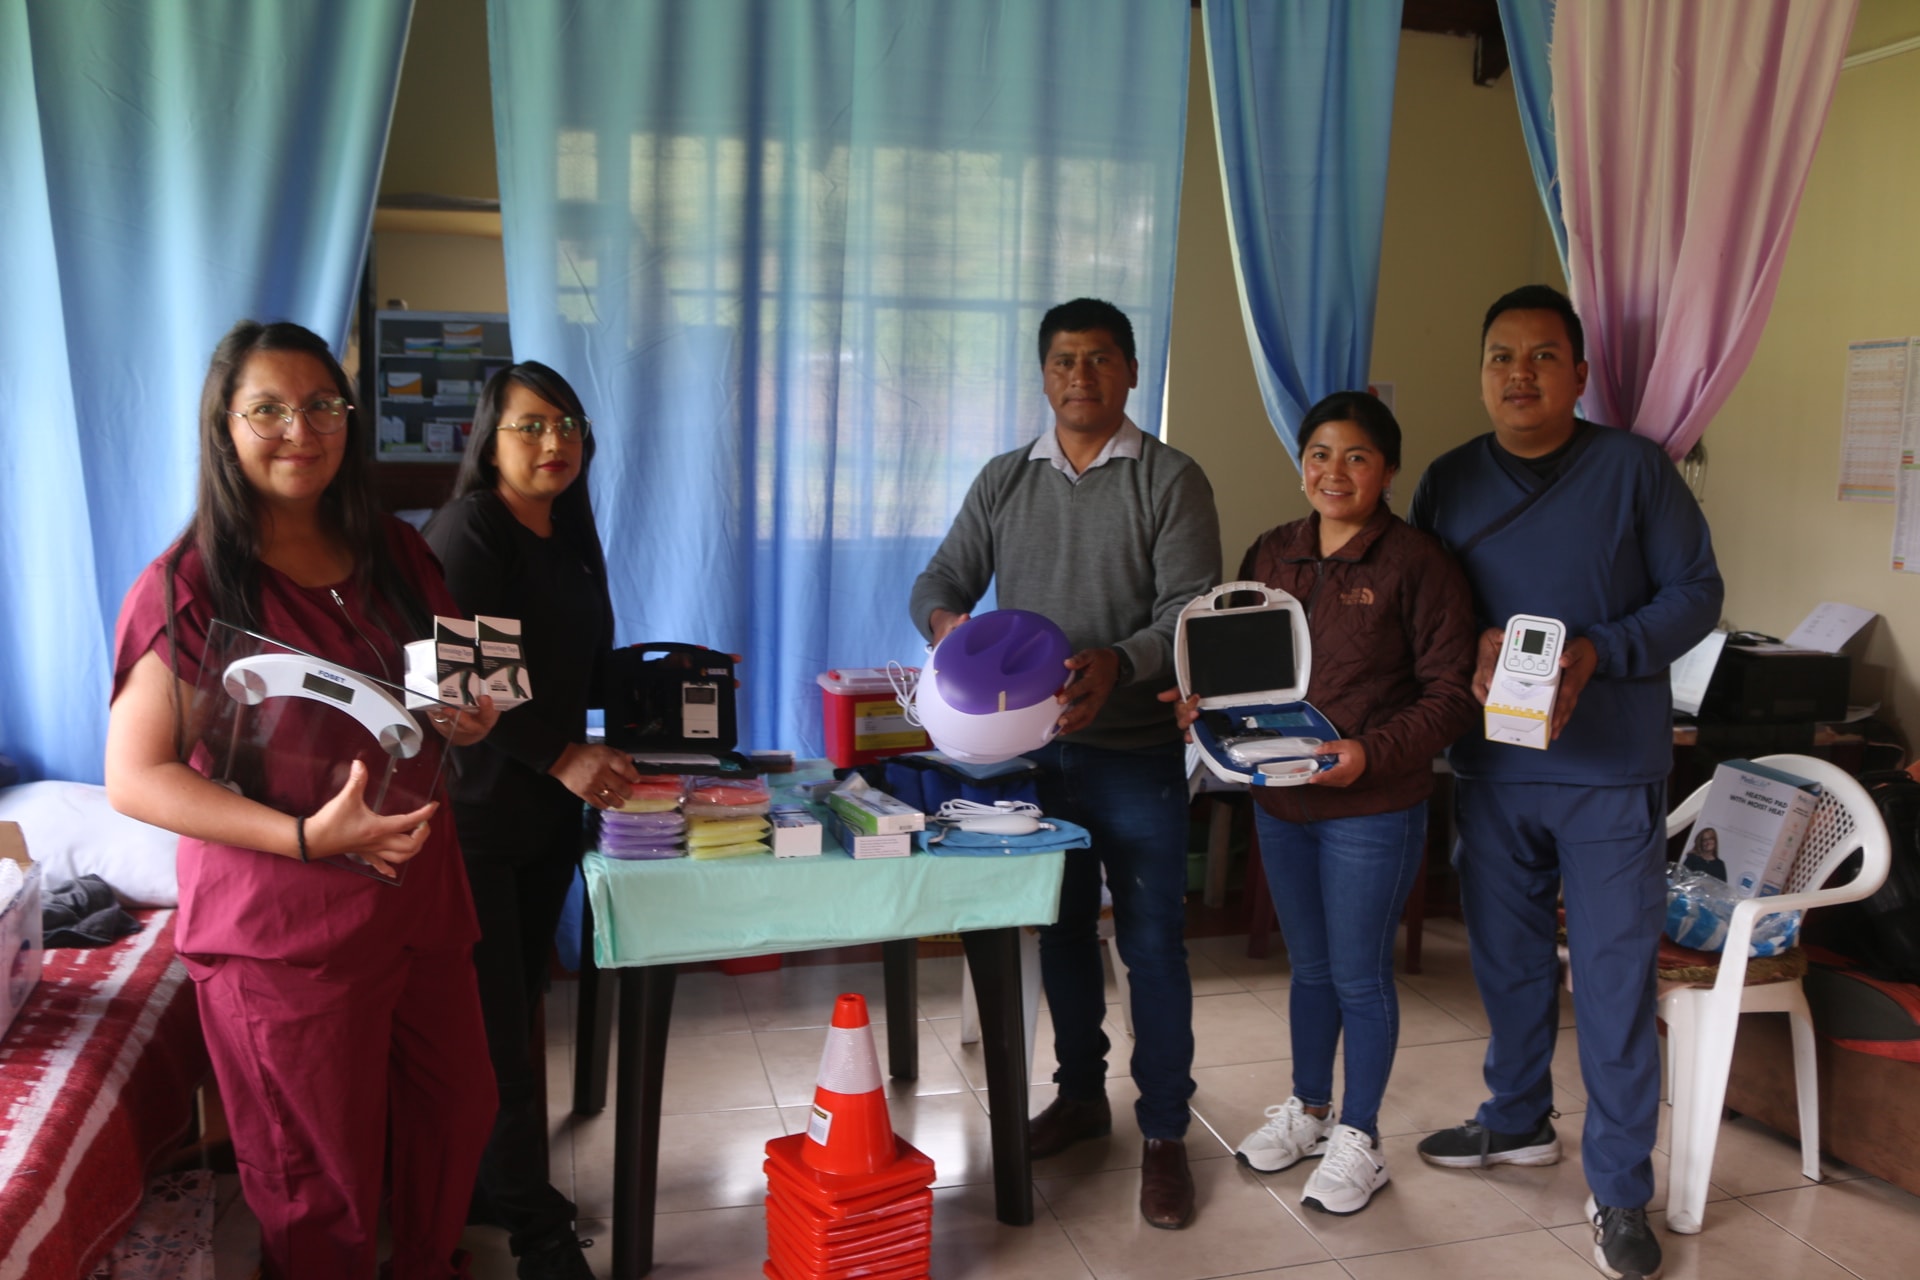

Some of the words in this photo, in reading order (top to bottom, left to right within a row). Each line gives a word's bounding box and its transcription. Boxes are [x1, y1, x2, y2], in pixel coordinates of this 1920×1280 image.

[1730, 794, 1746, 804] WITH
[1747, 800, 1768, 811] MOIST
[1768, 807, 1786, 817] HEAT
[1745, 791, 1773, 804] HEATING
[1774, 799, 1788, 809] PAD
